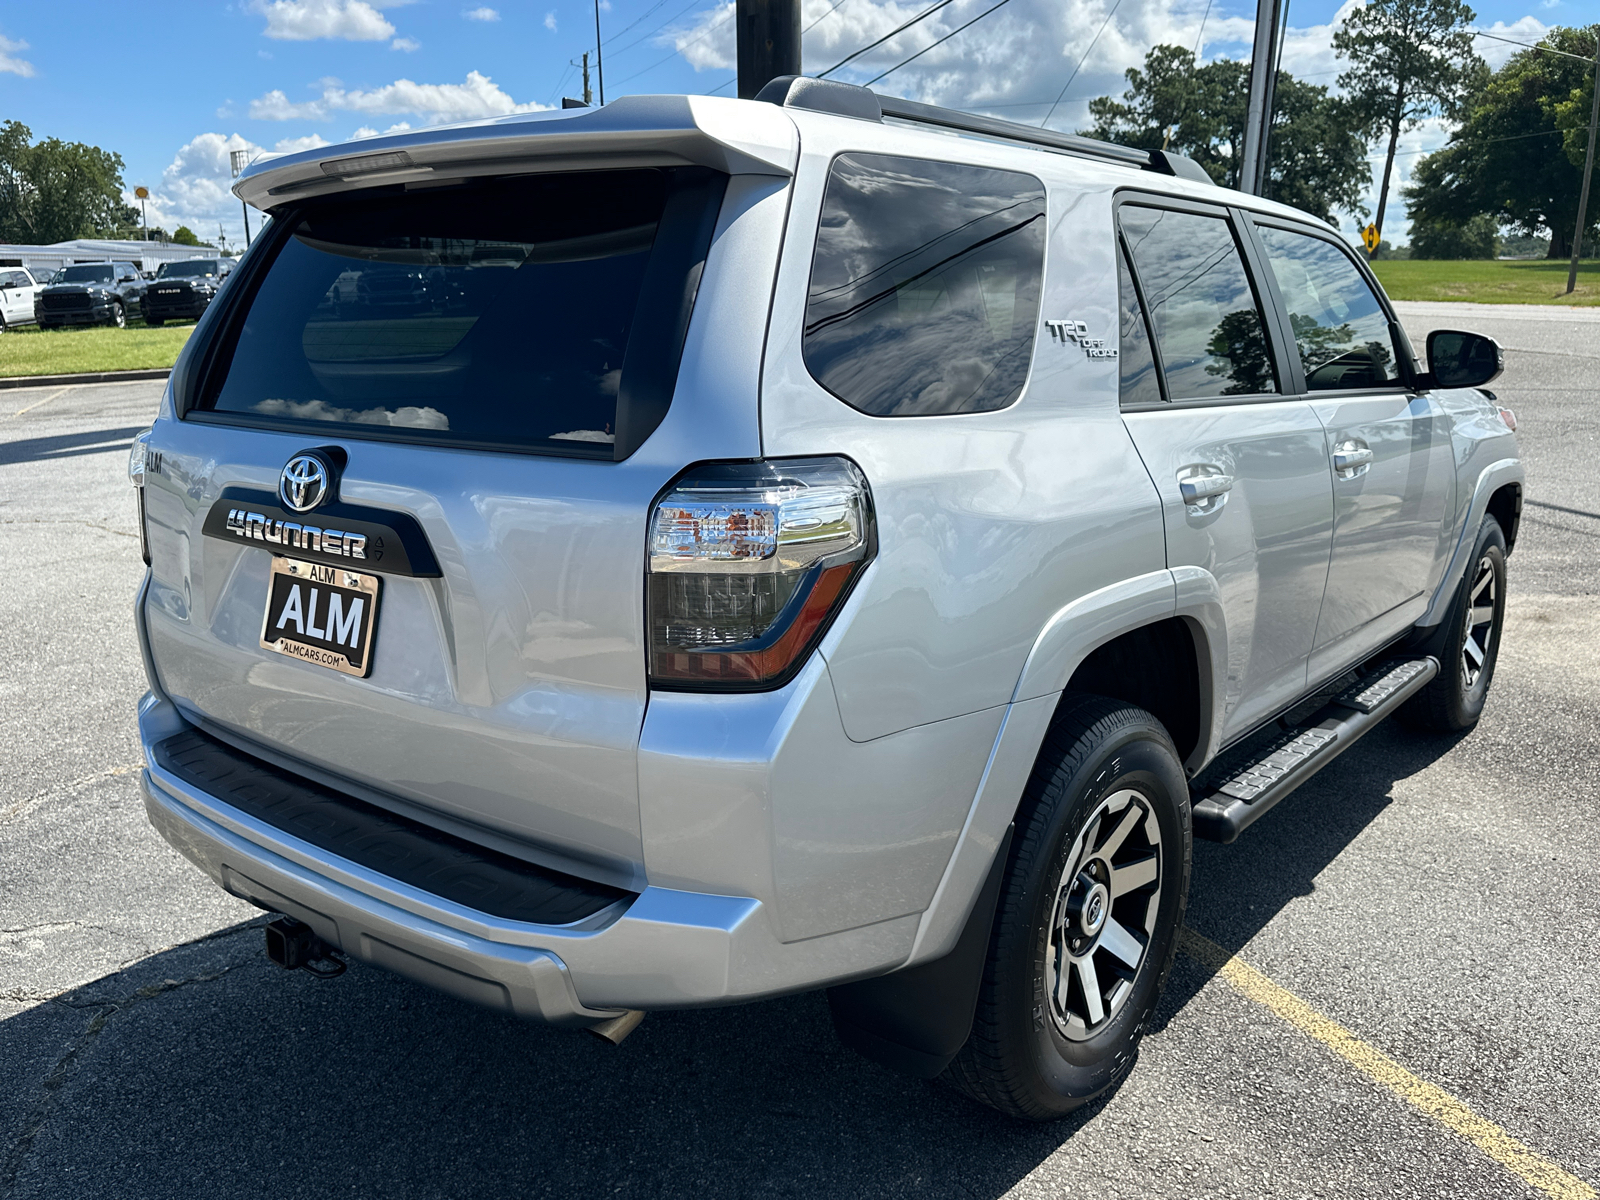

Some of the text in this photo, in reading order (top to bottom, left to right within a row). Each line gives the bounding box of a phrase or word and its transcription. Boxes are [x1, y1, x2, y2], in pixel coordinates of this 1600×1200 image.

[1045, 319, 1088, 343] TRD
[1080, 339, 1105, 348] OFF
[1086, 348, 1118, 358] ROAD
[144, 451, 162, 474] ALM
[226, 508, 368, 559] 4RUNNER
[309, 565, 336, 584] ALM
[276, 584, 364, 649] ALM
[283, 643, 340, 667] ALMCARS.COM
